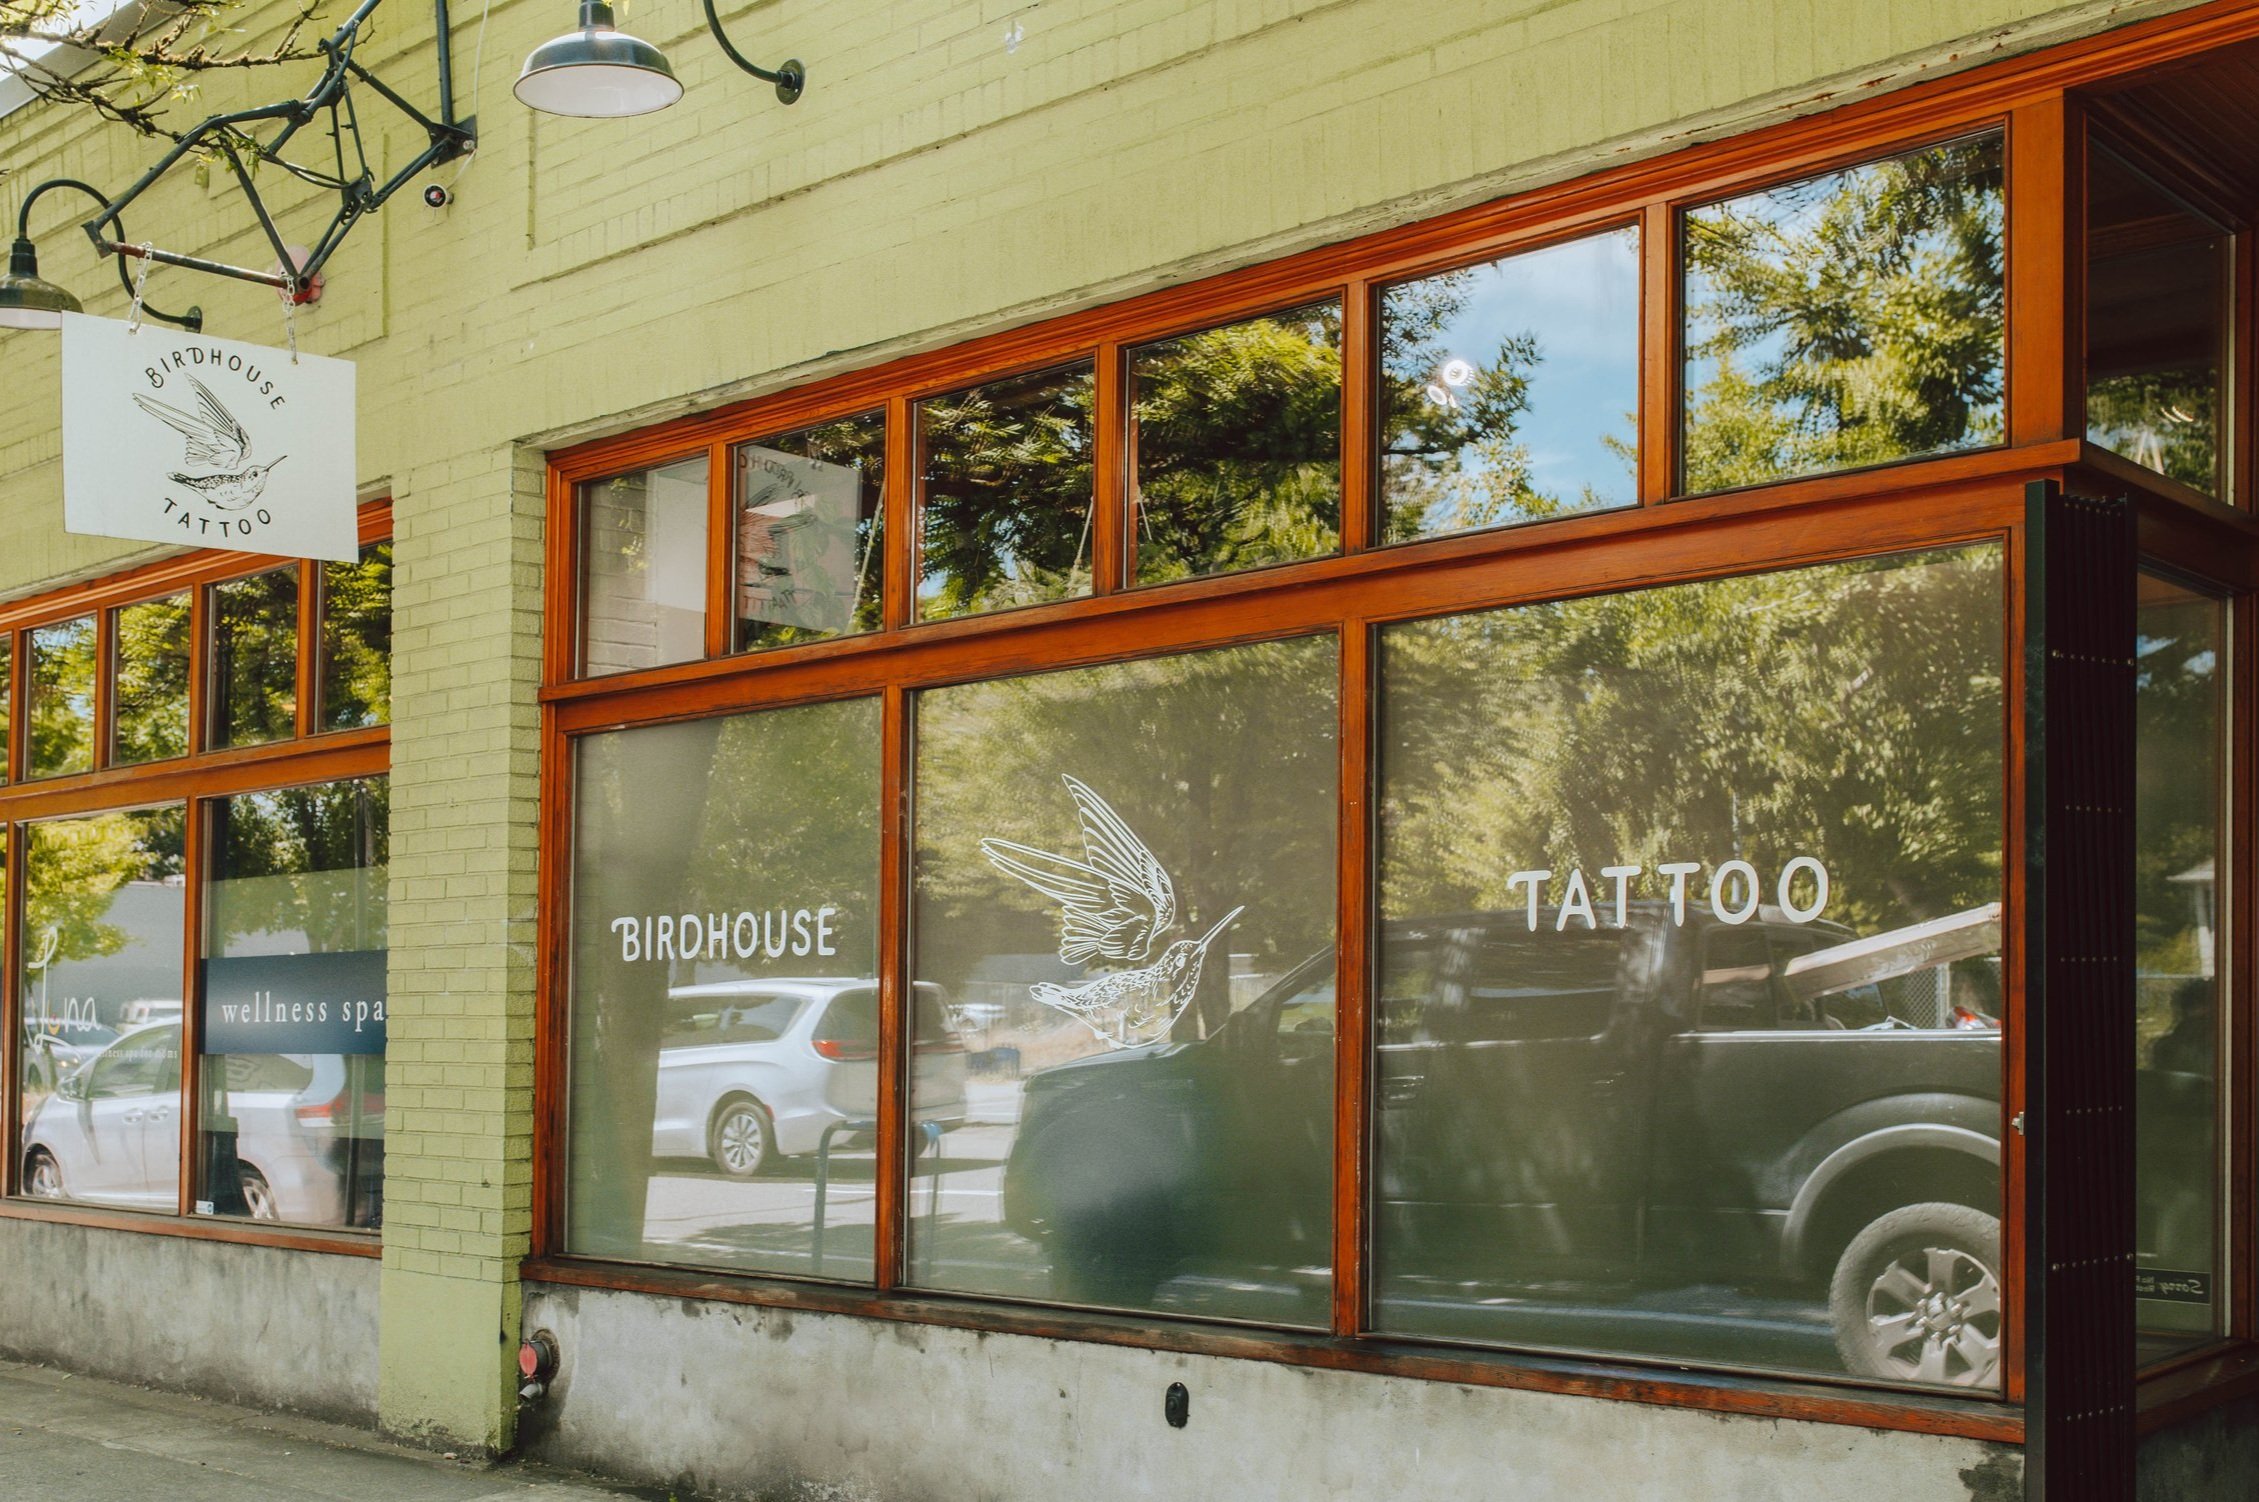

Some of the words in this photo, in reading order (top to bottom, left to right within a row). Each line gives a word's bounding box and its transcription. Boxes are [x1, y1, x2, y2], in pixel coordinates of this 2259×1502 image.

[145, 347, 285, 410] BIRDHOUSE
[164, 498, 271, 538] TATTOO
[1507, 856, 1829, 932] TATTOO
[611, 907, 836, 961] BIRDHOUSE
[222, 991, 328, 1023] wellness
[342, 1000, 384, 1032] spa
